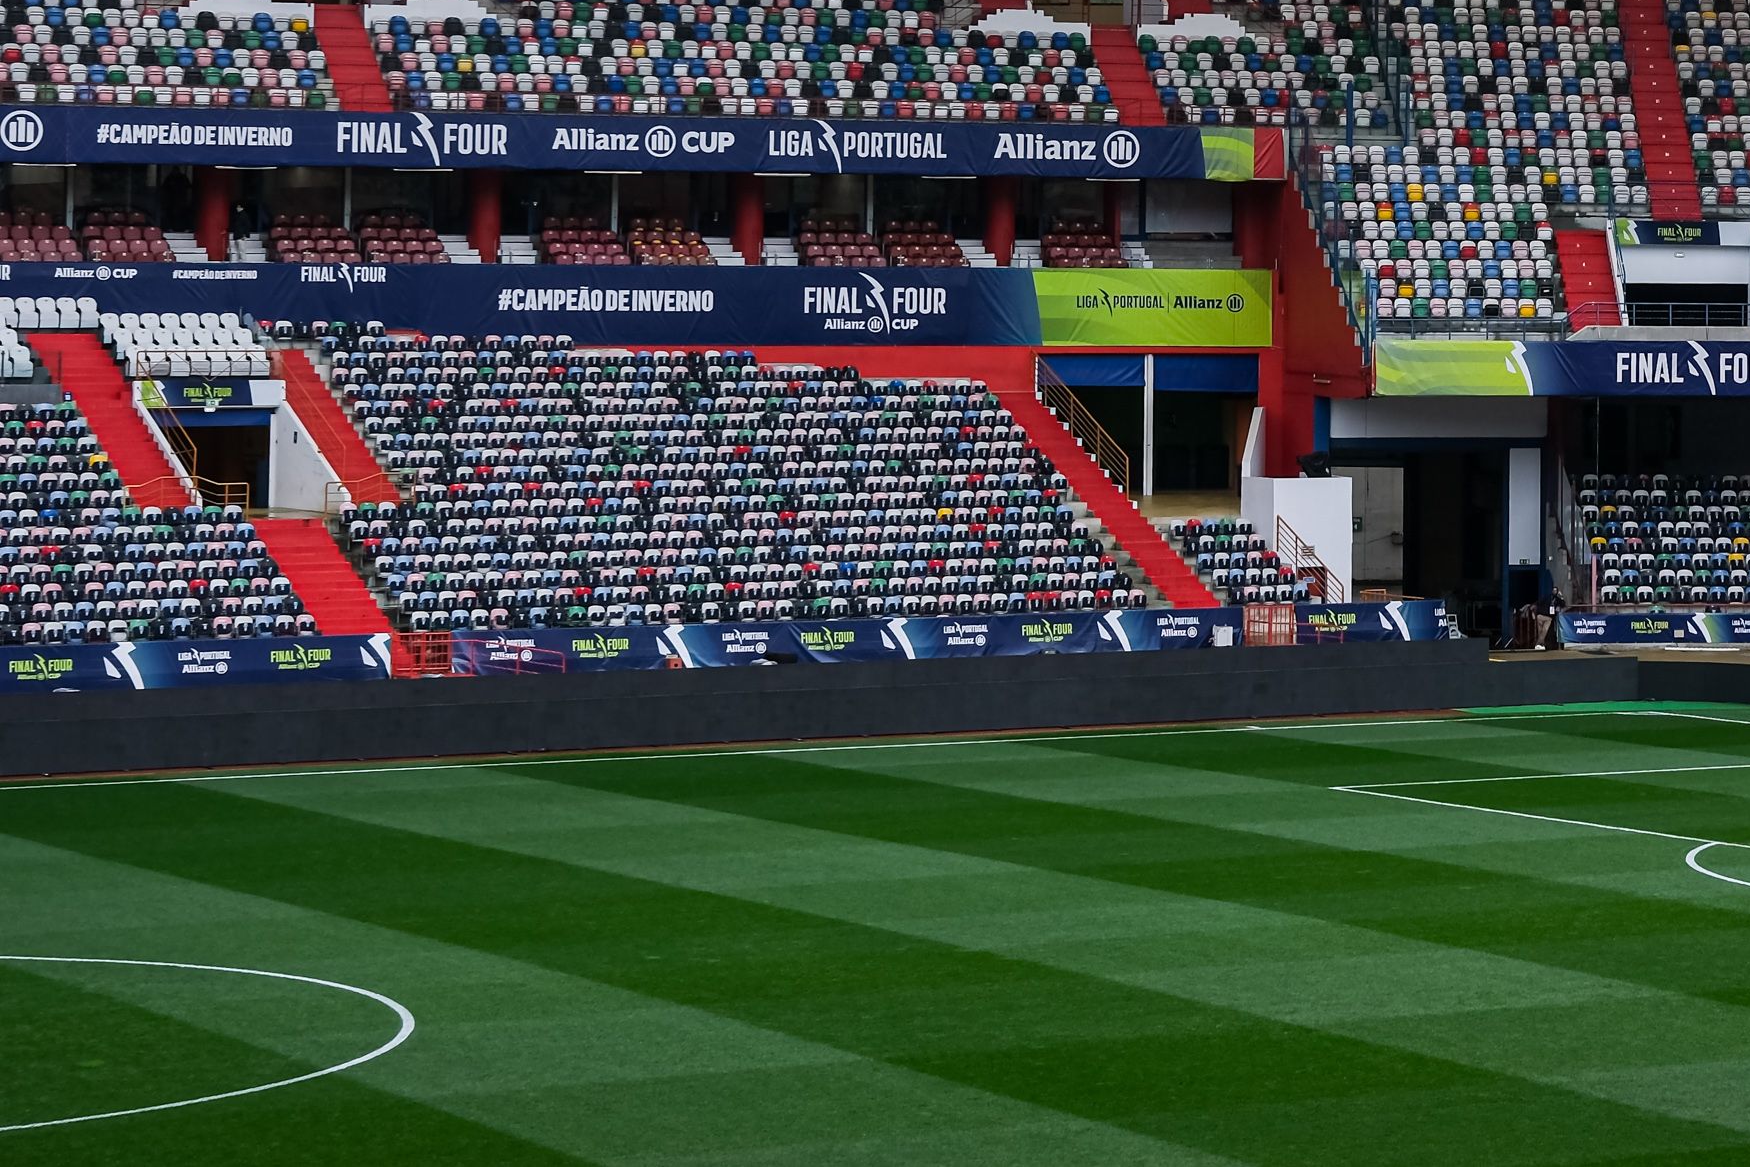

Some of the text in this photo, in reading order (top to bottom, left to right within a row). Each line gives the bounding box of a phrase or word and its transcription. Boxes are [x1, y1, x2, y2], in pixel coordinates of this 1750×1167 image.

[337, 121, 508, 156] FINAL FOUR
[552, 127, 735, 154] Allianz CUP
[769, 130, 947, 160] LIGA PORTUGAL
[994, 132, 1096, 161] Allianz
[1658, 227, 1701, 237] FINAL FOUR
[54, 267, 138, 279] Allianz CUP
[301, 266, 386, 283] FINAL FOUR
[804, 287, 946, 315] FINAL FOUR
[1077, 295, 1165, 310] LIGA PORTUGAL
[1173, 296, 1223, 310] Allianz
[824, 319, 919, 331] Allianz CUP
[1617, 352, 1684, 383] FINAL
[1156, 617, 1168, 626] LIGA
[1308, 612, 1356, 625] FINAL FOUR
[943, 625, 956, 634] LIGA
[1021, 623, 1073, 636] FINAL FOUR
[1160, 627, 1187, 637] Allianz
[722, 632, 735, 642] LIGA
[800, 631, 855, 644] FINAL FOUR
[947, 636, 975, 646] Allianz
[572, 638, 629, 652] FINAL FOUR
[726, 643, 755, 653] Allianz
[270, 648, 331, 663] FINAL FOUR
[9, 659, 73, 673] FINAL FOUR
